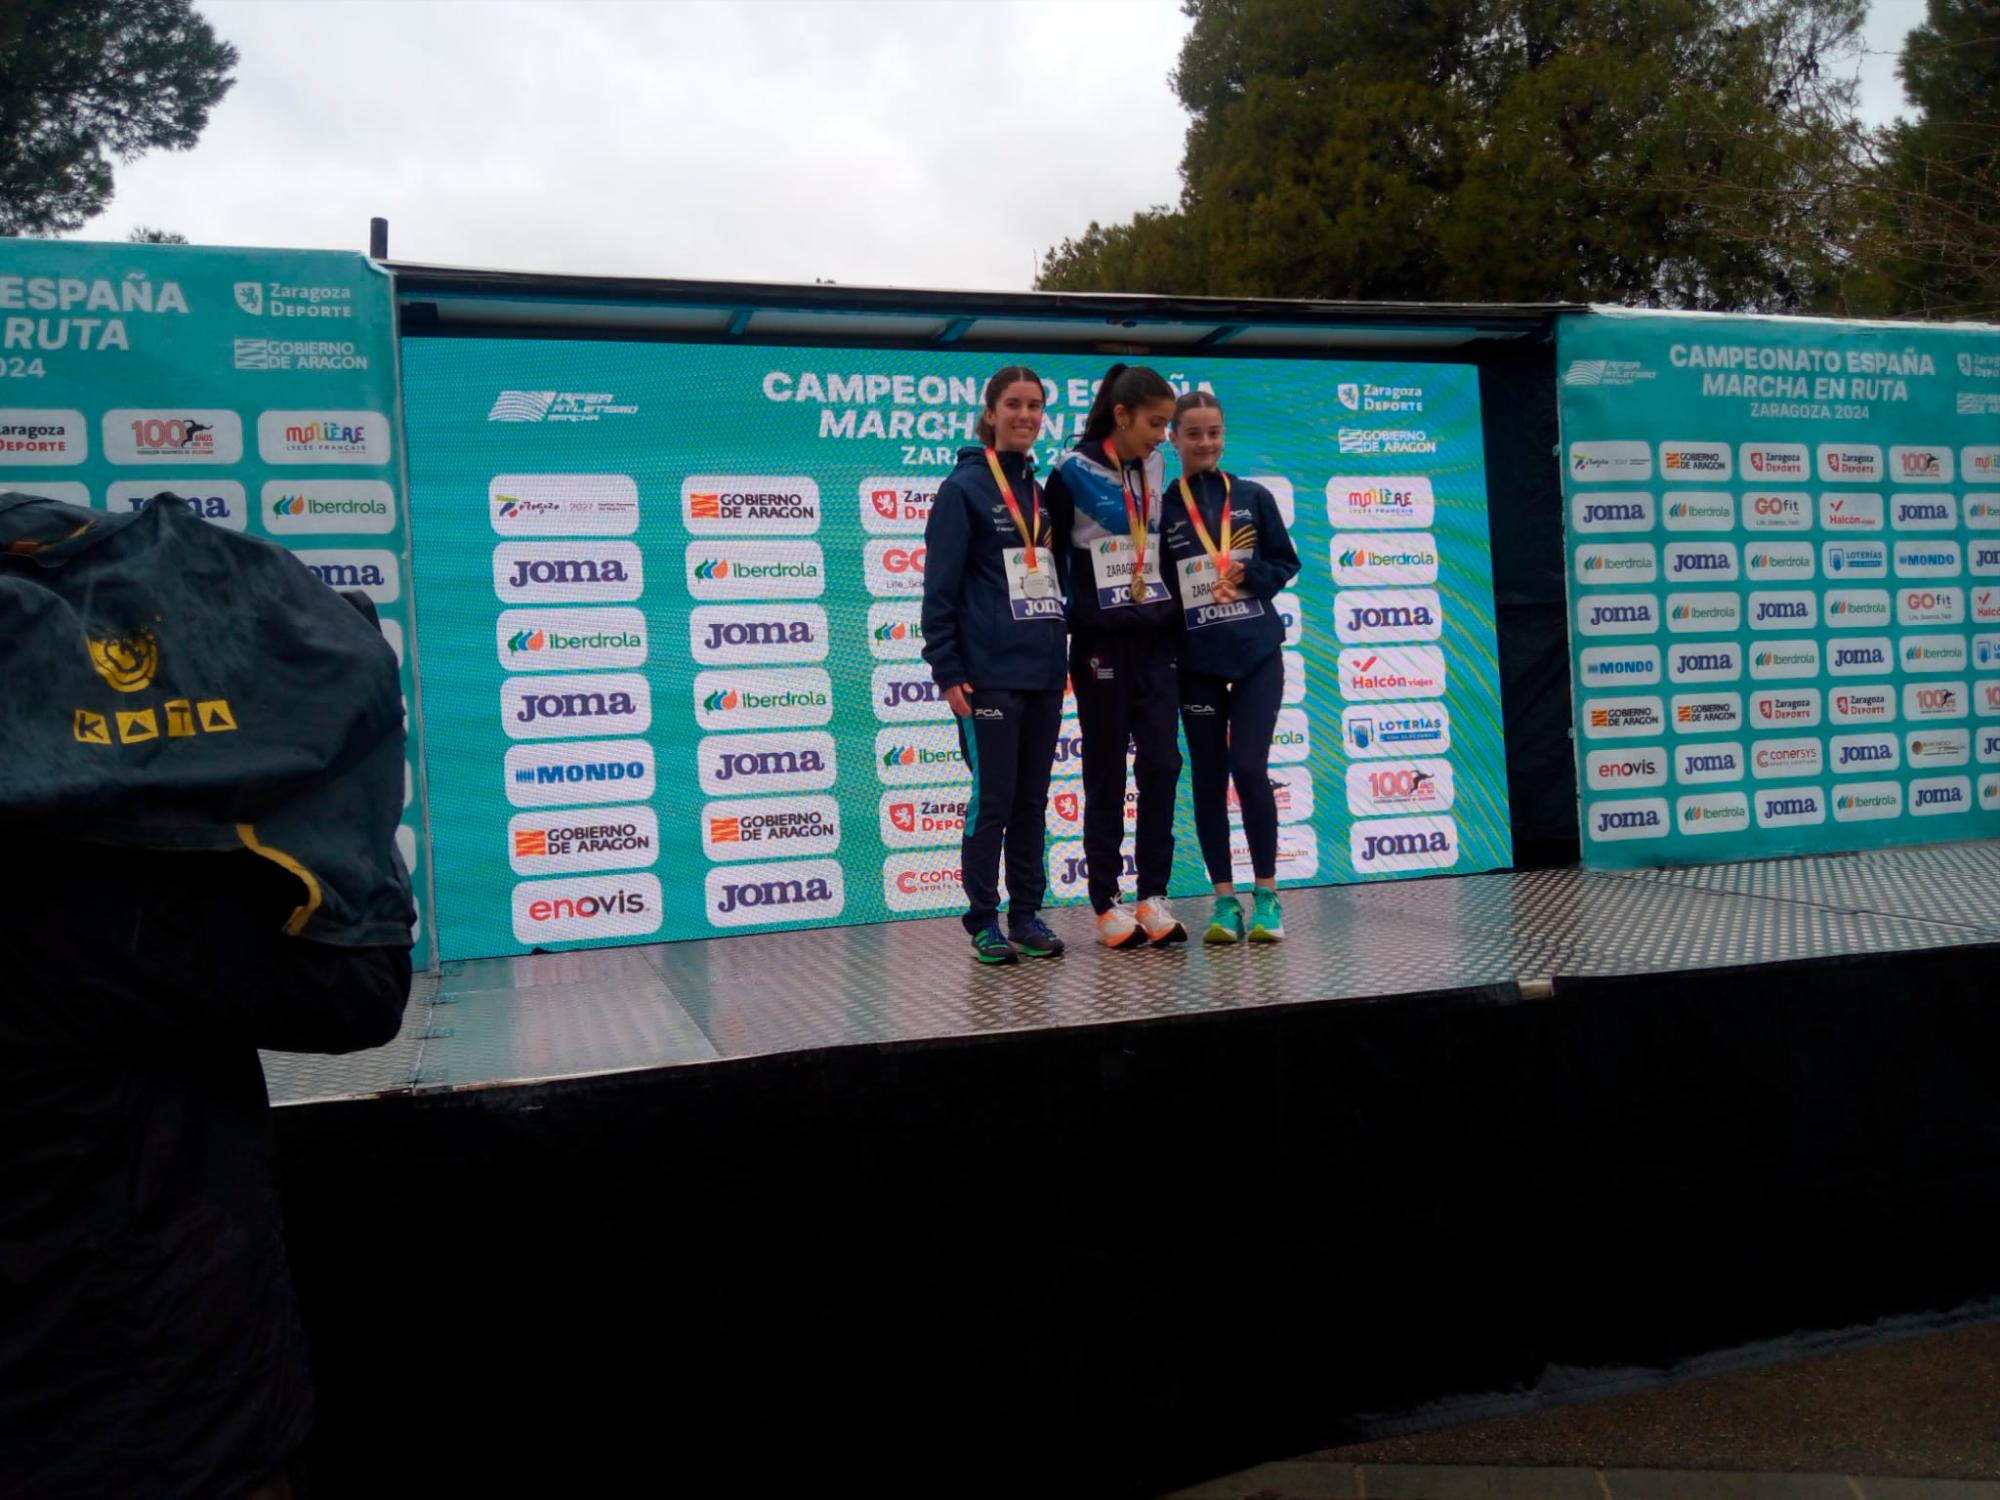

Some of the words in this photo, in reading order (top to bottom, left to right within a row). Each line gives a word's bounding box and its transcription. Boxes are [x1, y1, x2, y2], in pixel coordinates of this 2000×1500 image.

[0, 272, 190, 314] ESPAÑA
[270, 283, 352, 301] Zaragoza
[4, 316, 130, 351] RUTA
[268, 341, 355, 355] GOBIERNO
[268, 355, 292, 369] DE
[1670, 343, 1841, 373] CAMPEONATO
[1847, 346, 1936, 376] ESPAÑA
[1363, 384, 1422, 400] Zaragoza
[1702, 372, 1809, 399] MARCHA
[1814, 378, 1846, 400] EN
[1851, 378, 1909, 401] RUTA
[1750, 403, 1832, 419] ZARAGOZA
[1835, 405, 1870, 420] 2024
[819, 409, 976, 440] MARCH
[0, 424, 65, 440] aragoza
[131, 419, 187, 448] 100
[1362, 430, 1426, 442] GOBIERNO
[1362, 441, 1379, 452] DE
[1680, 453, 1719, 462] GOBIERNO
[1766, 453, 1800, 464] Zaragoza
[1902, 453, 1928, 472] 100
[1680, 461, 1691, 470] DE
[308, 499, 387, 515] Iberdrola
[720, 493, 802, 507] GOBIERNO
[720, 506, 742, 519] DE
[1688, 505, 1731, 518] Iberdrola
[1368, 552, 1434, 566] Iberdrola
[1768, 555, 1810, 568] Iberdrola
[1846, 549, 1883, 560] LOTERÍAS
[1907, 554, 1955, 566] MONDO
[733, 562, 817, 578] Iberdrola
[1604, 558, 1653, 569] Iberdrola
[306, 563, 384, 586] ma
[1111, 585, 1158, 604] Joa
[1691, 606, 1736, 619] Iberdrola
[1848, 602, 1886, 614] Iberdrola
[549, 631, 641, 650] Iberdrola
[1773, 652, 1815, 664] Iberdrola
[1924, 647, 1962, 658] Iberdrola
[1600, 660, 1654, 675] MONDO
[1352, 675, 1406, 690] Halcón
[742, 690, 826, 708] Iberdrola
[1851, 695, 1885, 708] Zaragoza
[1917, 690, 1943, 708] 100
[1986, 687, 2000, 706] 10
[1691, 703, 1730, 714] GOBIERNO
[1775, 699, 1810, 709] Zaragoza
[1608, 707, 1652, 718] GOBIERNO
[1691, 713, 1701, 722] DE
[1379, 717, 1441, 731] LOTERÍAS
[1608, 717, 1620, 727] DE
[537, 761, 645, 784] MONDO
[1599, 758, 1656, 778] enovis
[1368, 770, 1413, 798] 100
[1855, 795, 1897, 807] Iberdrola
[921, 802, 968, 817] Zarag
[1703, 807, 1746, 819] Iberdrola
[740, 812, 822, 828] GOBIERNO
[922, 818, 965, 831] DEPO
[548, 824, 637, 842] GOBIERNO
[740, 827, 762, 841] DE
[548, 842, 571, 856] DE
[920, 869, 962, 883] cone
[528, 889, 646, 921] enovis
